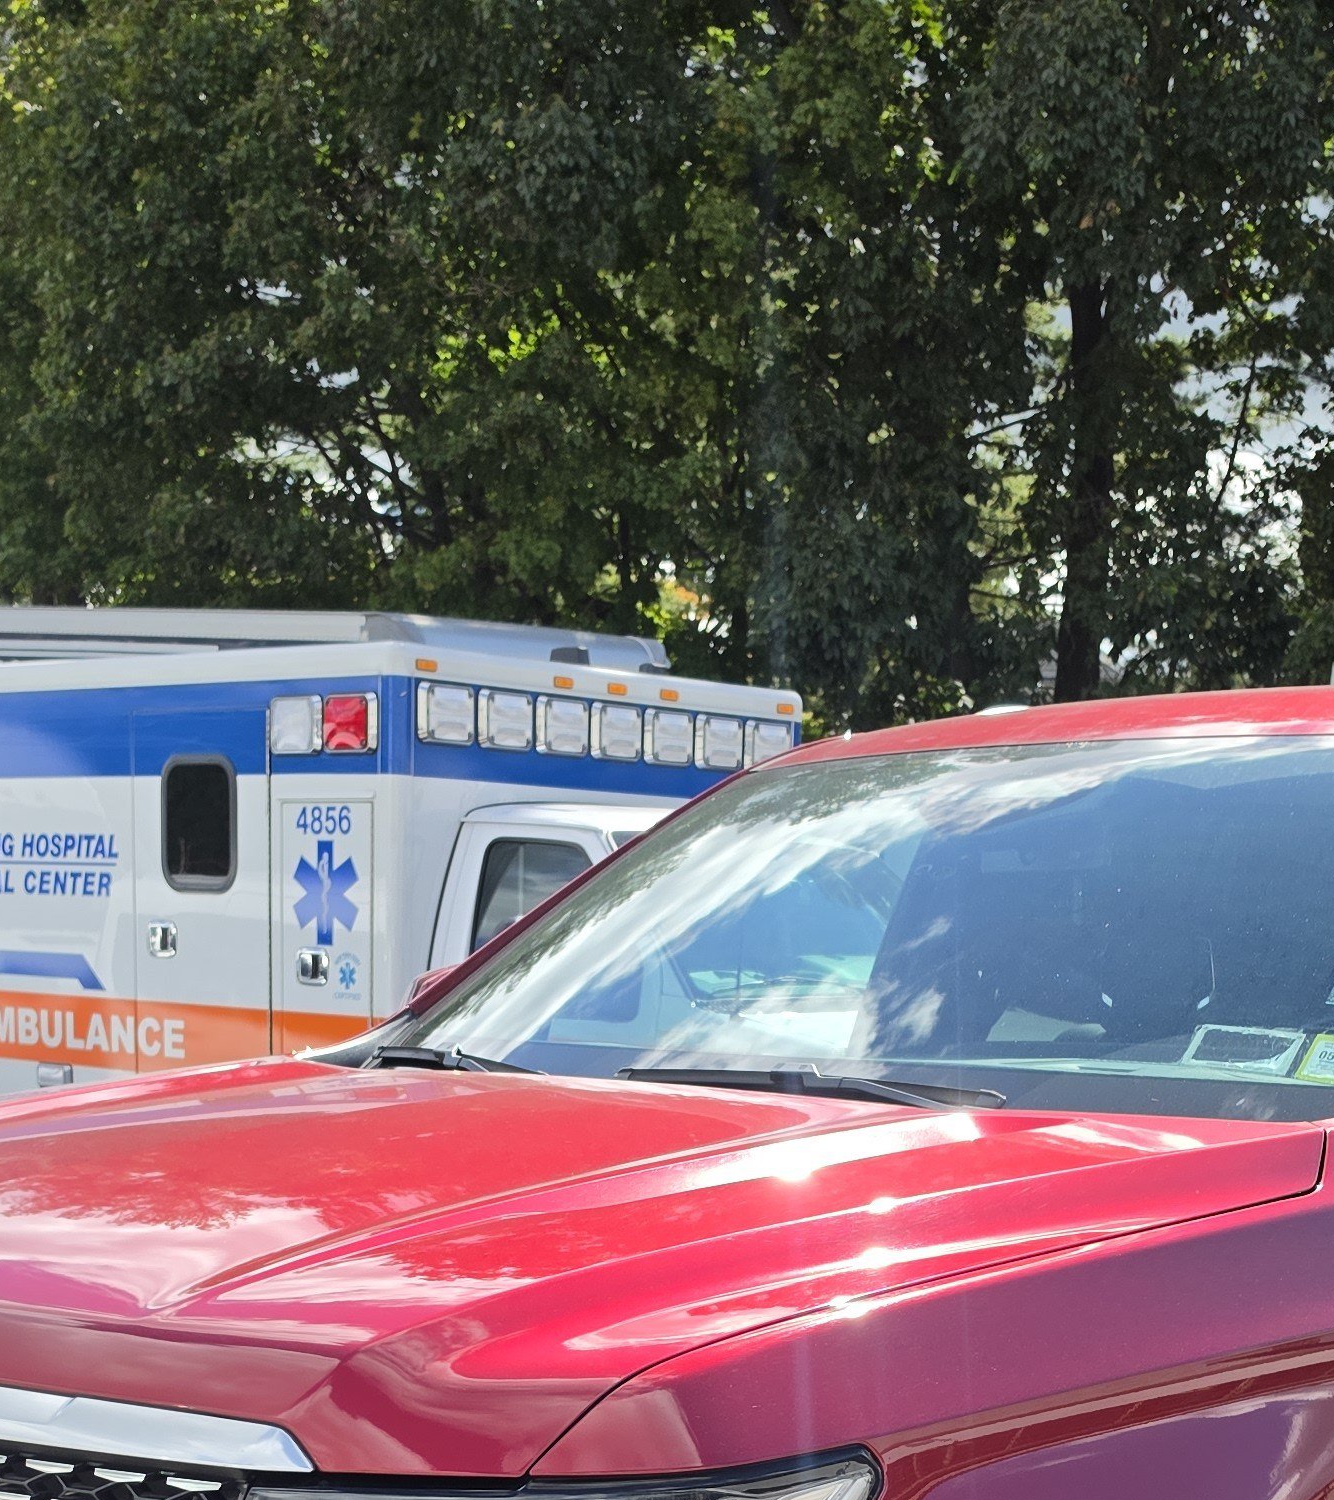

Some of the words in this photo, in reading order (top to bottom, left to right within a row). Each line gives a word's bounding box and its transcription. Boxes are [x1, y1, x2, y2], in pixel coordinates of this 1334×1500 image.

[296, 805, 351, 834] 4856
[22, 834, 119, 858] HOSPITAL
[24, 870, 112, 897] CENTER
[1318, 1050, 1334, 1061] 05
